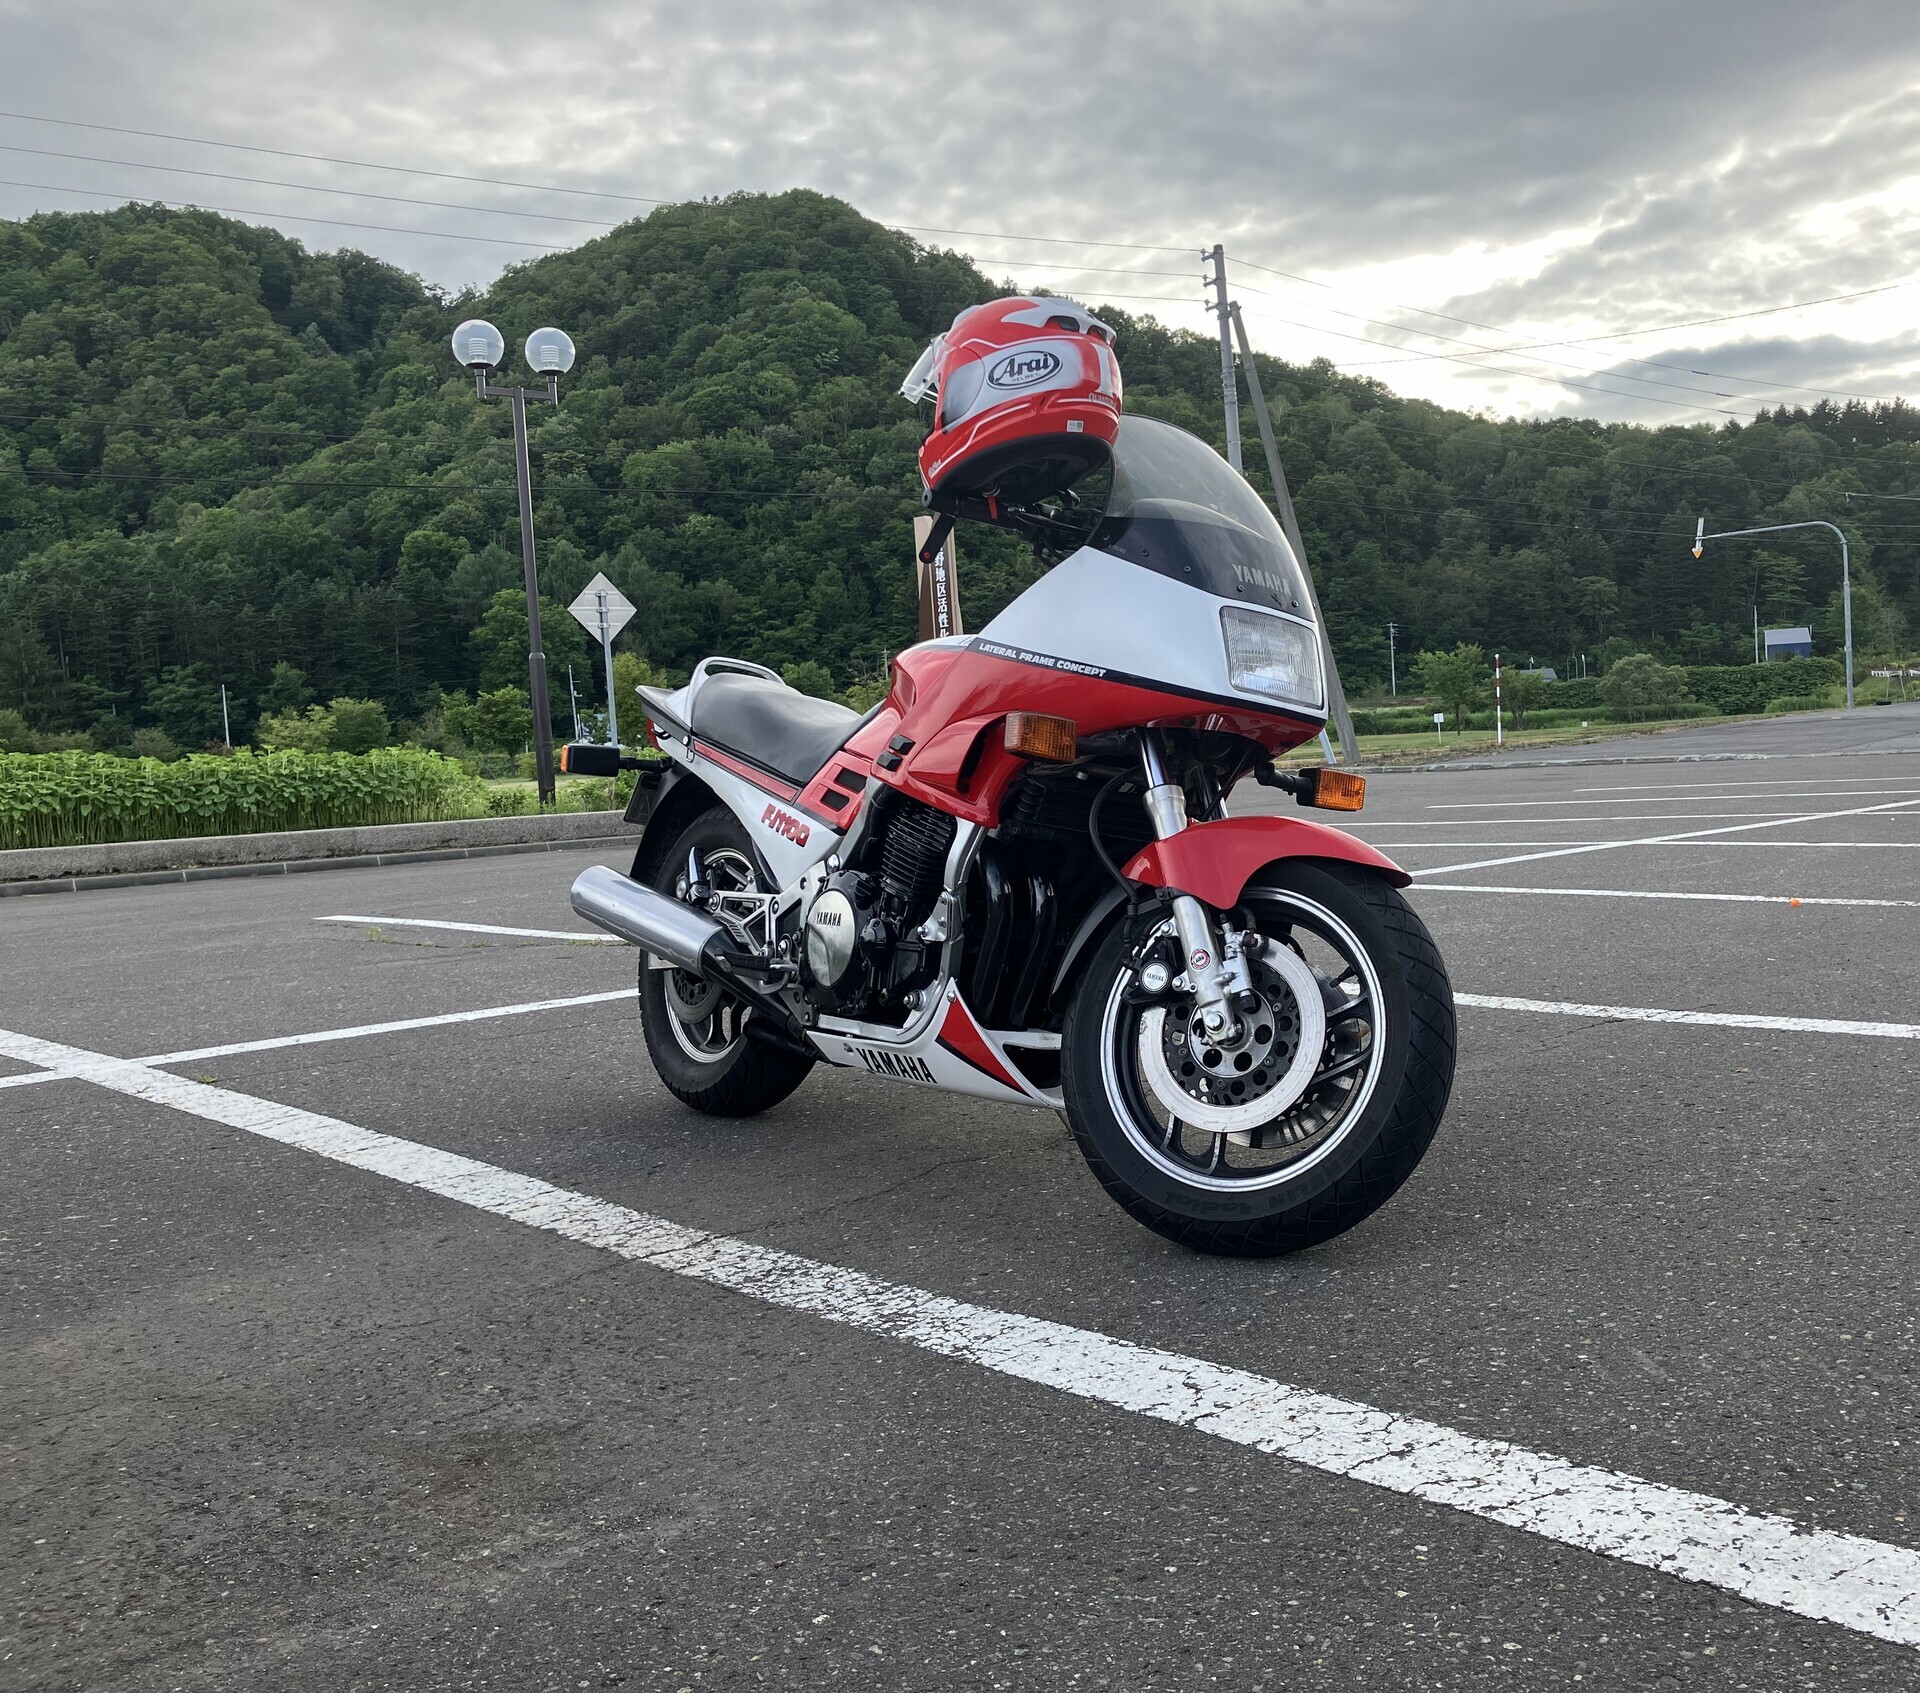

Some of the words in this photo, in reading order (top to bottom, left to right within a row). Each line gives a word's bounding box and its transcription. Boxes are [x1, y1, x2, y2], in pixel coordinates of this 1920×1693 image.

[995, 353, 1051, 383] Arai
[1232, 564, 1292, 596] YAMAHA
[979, 642, 1017, 658] LATERAL
[1019, 652, 1055, 667] FRAME
[1056, 660, 1107, 678] CONCEPT
[761, 803, 810, 848] FJ1100
[816, 912, 842, 927] YAMAHA
[856, 1047, 938, 1084] YAMAHA
